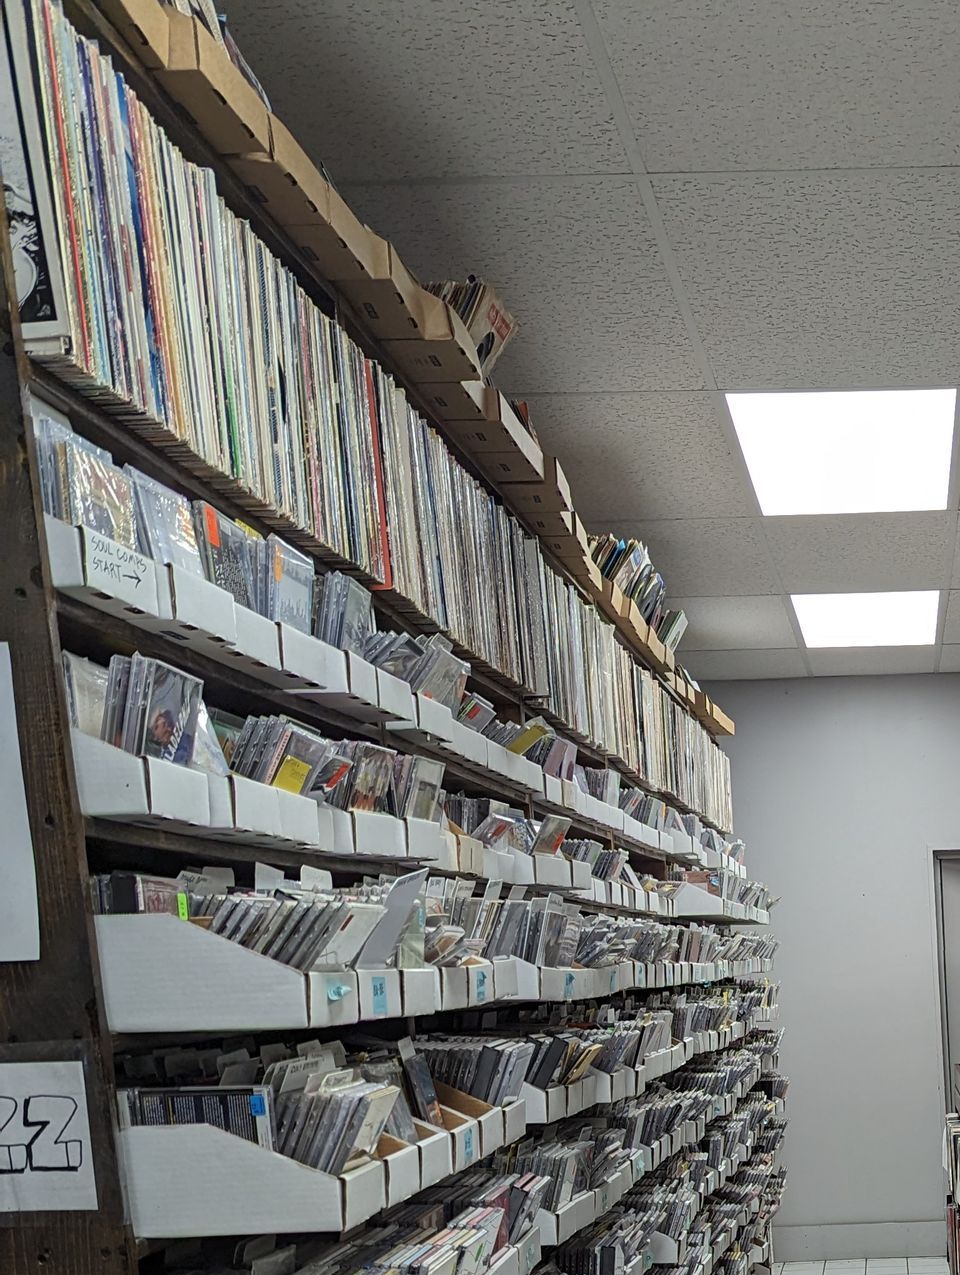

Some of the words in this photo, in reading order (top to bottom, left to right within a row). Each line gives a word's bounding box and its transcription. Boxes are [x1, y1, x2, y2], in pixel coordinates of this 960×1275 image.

[91, 536, 114, 556] SOUL
[116, 548, 147, 574] COMPS
[92, 556, 122, 583] START
